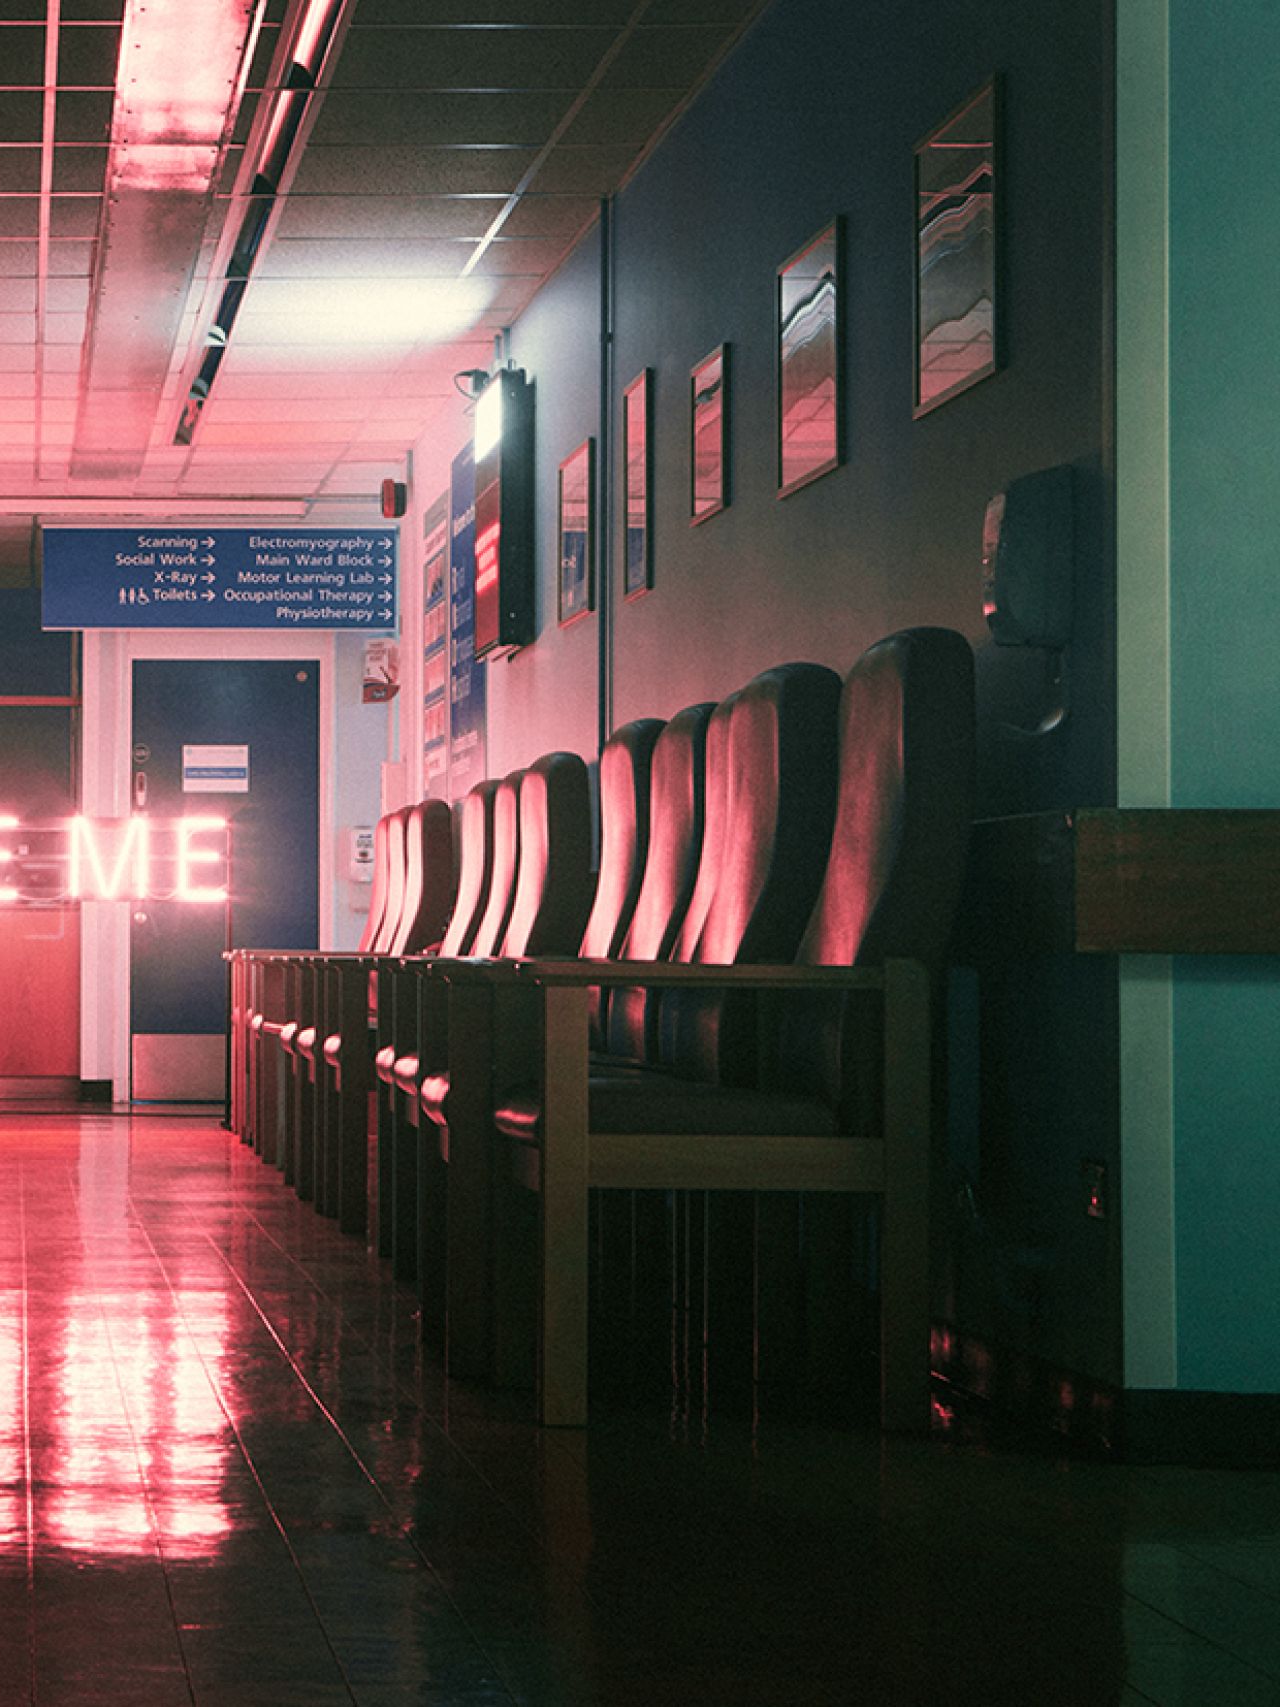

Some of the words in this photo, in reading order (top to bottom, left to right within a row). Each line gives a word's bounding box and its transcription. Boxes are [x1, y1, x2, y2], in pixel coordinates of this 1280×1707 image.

[137, 536, 198, 551] Scanning
[249, 536, 375, 551] Electromyography
[115, 553, 155, 565] Social
[160, 553, 197, 565] Work
[255, 554, 290, 565] Main
[294, 554, 333, 565] Ward
[337, 554, 374, 566] Block
[154, 571, 197, 586] X-Ray
[237, 571, 281, 583] Motor
[286, 572, 345, 586] Learning
[350, 572, 375, 583] Lab
[152, 587, 197, 601] Toilets
[224, 588, 313, 603] Occupational
[318, 589, 375, 604] Therapy
[276, 606, 375, 621] Physiotherapy
[68, 816, 228, 900] ME
